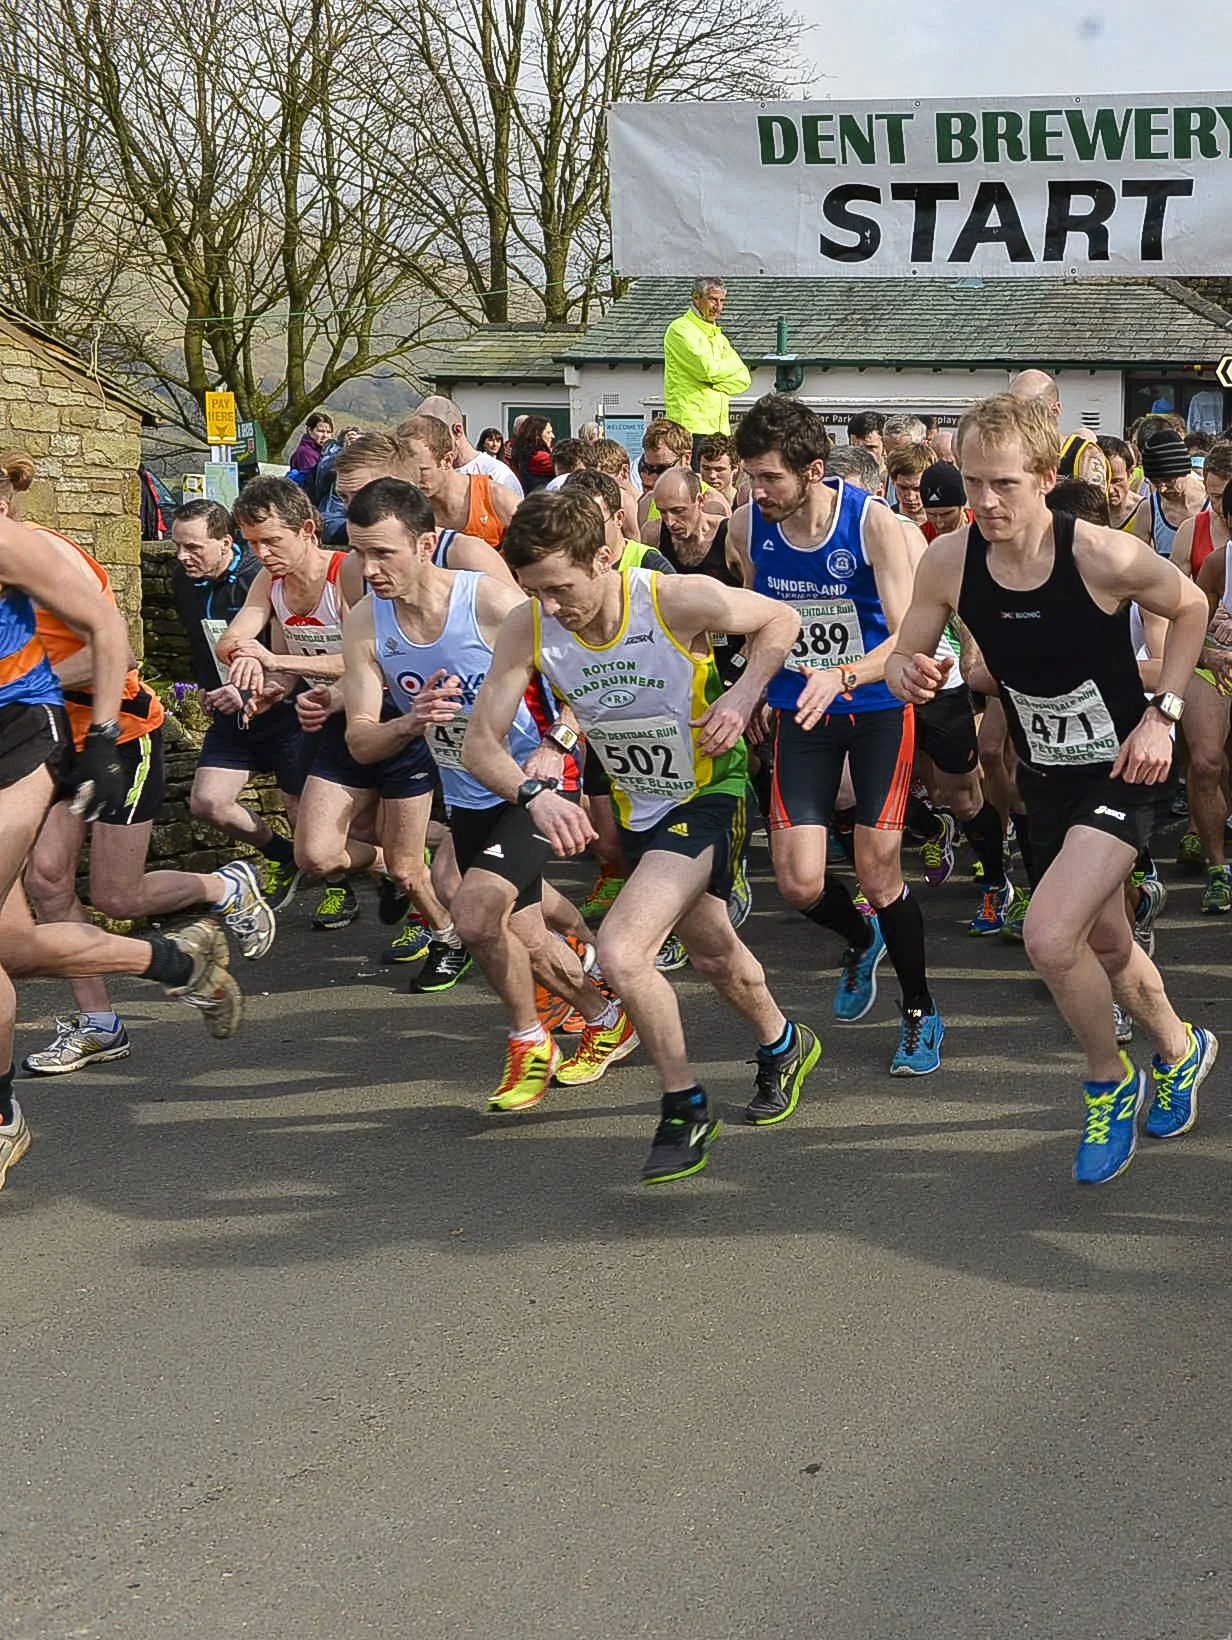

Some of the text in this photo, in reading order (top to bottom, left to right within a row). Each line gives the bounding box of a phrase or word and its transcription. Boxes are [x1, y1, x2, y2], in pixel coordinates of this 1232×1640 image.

[757, 112, 914, 166] DENT
[819, 178, 1194, 264] START
[212, 399, 230, 409] PAY
[208, 411, 234, 422] HERE
[767, 575, 848, 596] SUNDERLAND
[582, 660, 636, 677] ROYTON
[656, 725, 678, 738] RUN
[1032, 711, 1095, 744] 471
[1030, 738, 1116, 755] PETE BLAND
[604, 743, 680, 779] 502
[647, 777, 694, 791] BLAND
